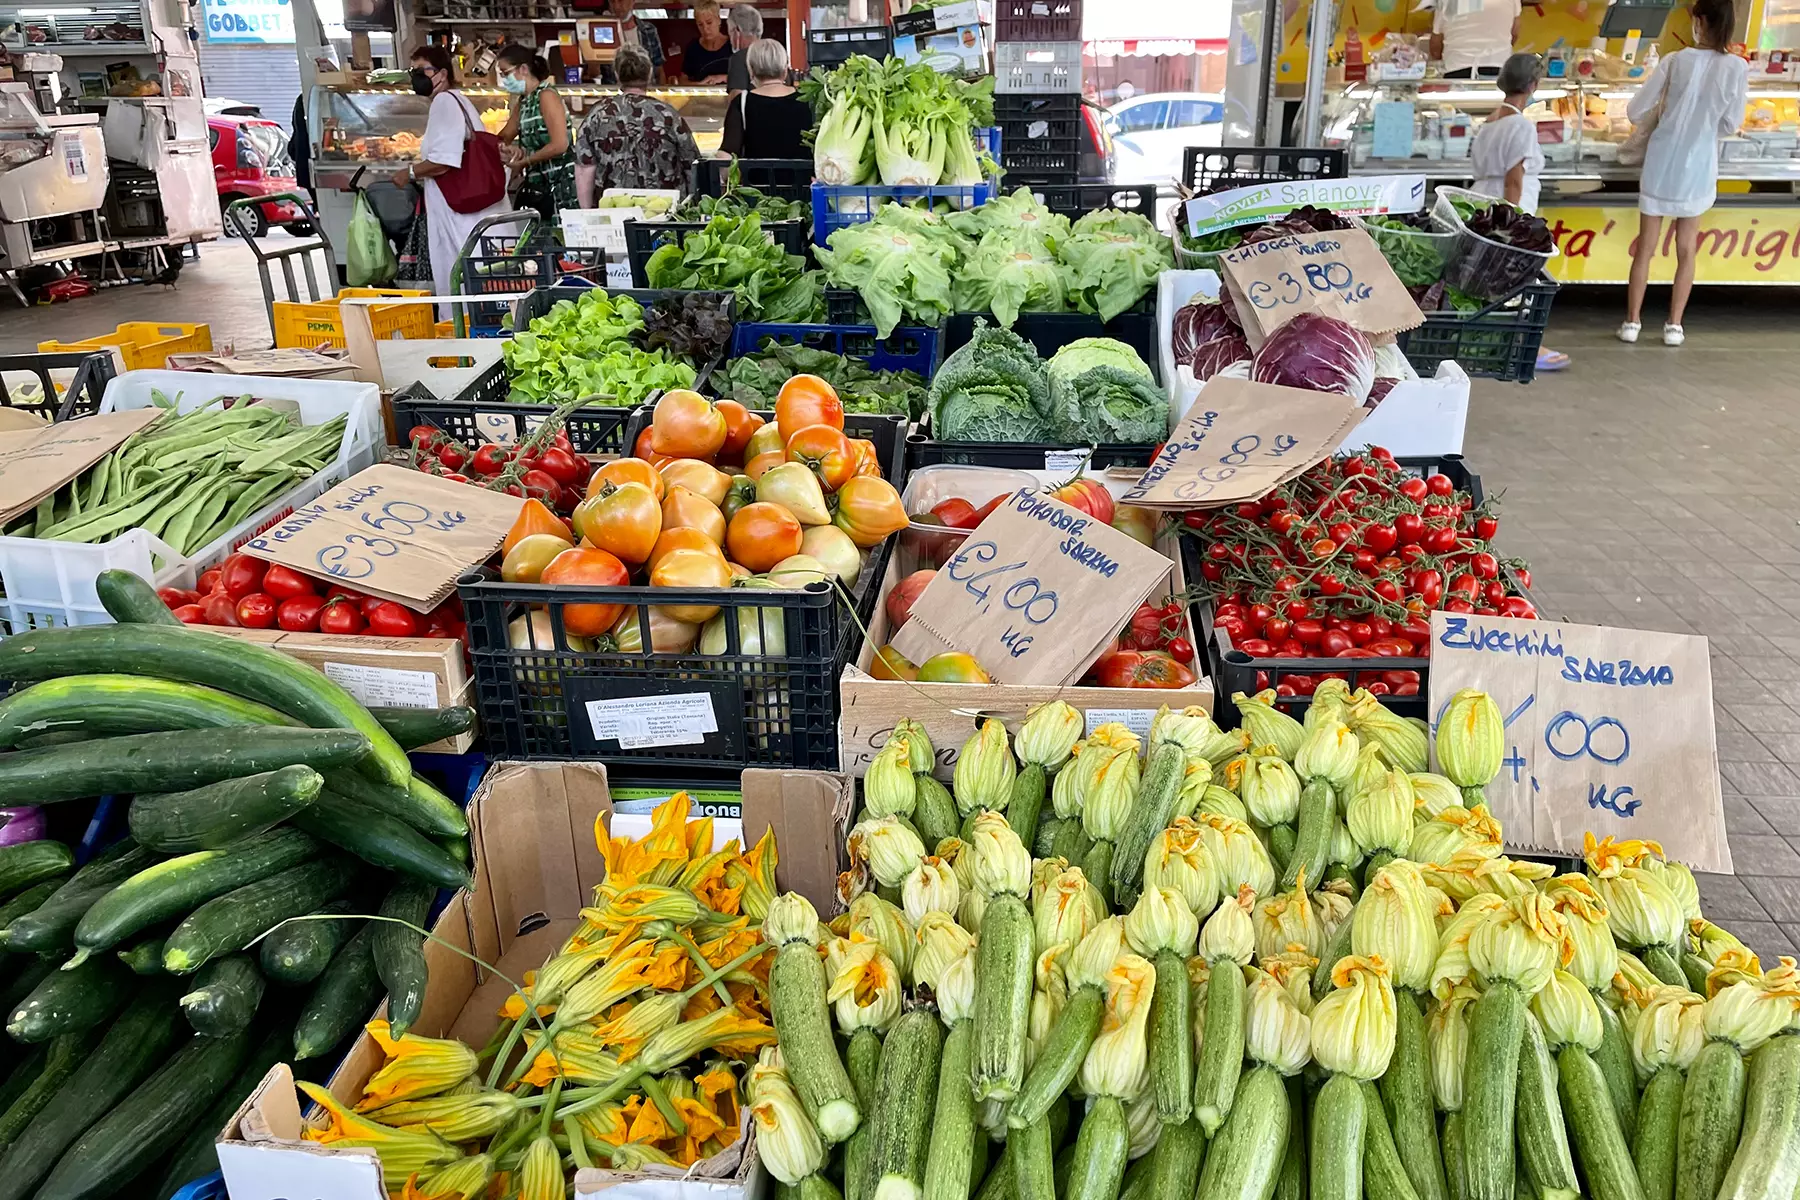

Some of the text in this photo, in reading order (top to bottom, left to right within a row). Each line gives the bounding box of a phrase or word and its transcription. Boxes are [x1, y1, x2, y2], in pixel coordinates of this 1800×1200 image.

[1281, 183, 1384, 204] Salanova
[1233, 216, 1265, 227] Agricola
[307, 322, 335, 332] PEMPA
[681, 698, 706, 706] Agricola
